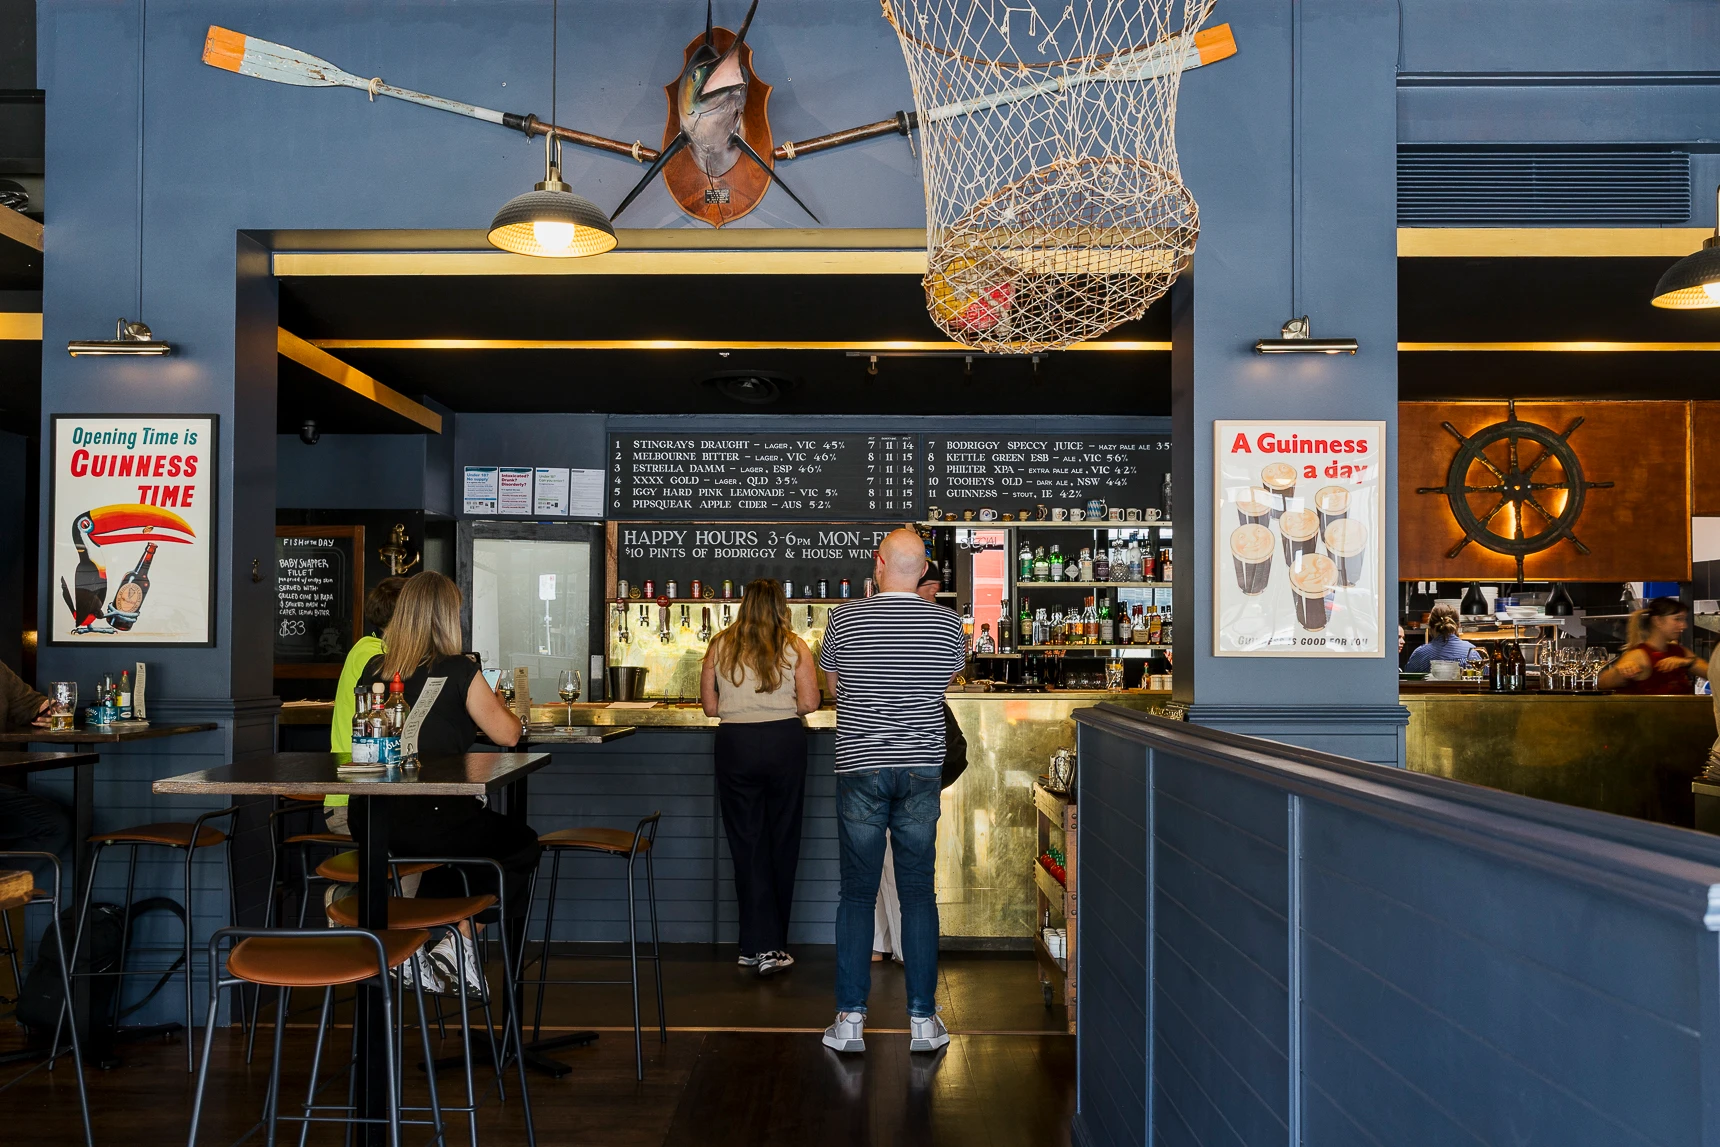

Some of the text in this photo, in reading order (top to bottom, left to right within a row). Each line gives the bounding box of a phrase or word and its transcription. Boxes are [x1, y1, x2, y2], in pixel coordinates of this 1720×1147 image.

[73, 427, 198, 449] Opening Time is
[1231, 432, 1368, 454] A Guinness
[615, 440, 621, 449] 1
[633, 439, 695, 450] STINGRAYS
[700, 440, 750, 450] DRAUGHT
[796, 440, 816, 450] VIC
[867, 440, 915, 449] 7 11 14
[928, 440, 936, 449] 7
[946, 440, 1001, 450] BODRIGGY
[1007, 441, 1048, 450] SPECCY
[1053, 440, 1084, 452] JUICE
[615, 451, 622, 460] 2
[632, 451, 697, 461] MELBOURNE
[701, 452, 740, 461] BITTER
[786, 452, 807, 462] VIC
[867, 452, 913, 461] 8 11 15
[927, 452, 935, 461] 8
[946, 452, 986, 462] KETTLE
[991, 453, 1025, 462] GREEN
[1030, 453, 1050, 462] ESB
[1082, 453, 1102, 462] VIC
[71, 449, 198, 478] GUINNESS
[614, 463, 621, 472] 3
[632, 463, 685, 473] ESTRELLA
[689, 464, 726, 473] DAMM
[772, 464, 793, 474] ESP
[867, 464, 915, 473] 7 11 14
[927, 464, 935, 473] 9
[946, 464, 987, 474] PHILTER
[993, 465, 1015, 474] XPA
[1090, 465, 1111, 475] VIC
[1303, 460, 1369, 484] a day
[614, 475, 622, 484] 4
[632, 475, 664, 485] XXXX
[669, 475, 700, 485] GOLD
[746, 476, 769, 487] QLD
[866, 476, 915, 485] 7 11 14
[928, 476, 939, 485] 10
[946, 476, 995, 486] TOOHEYS
[1001, 476, 1023, 486] OLD
[1076, 477, 1101, 486] NSW
[138, 485, 195, 508] TIME
[613, 487, 838, 497] 5 IGGY HARD PINK LEMONADE VIC 5%
[868, 488, 913, 497] 8 11 15
[928, 488, 937, 497] 11
[946, 488, 998, 498] GUINNESS
[1041, 489, 1053, 498] IE
[613, 499, 621, 508] 6
[632, 499, 693, 510] PIPSQUEAK
[699, 499, 732, 509] APPLE
[738, 499, 768, 509] CIDER
[780, 500, 802, 509] AUS
[868, 500, 913, 509] 8 11 15
[283, 538, 304, 546] FISH
[318, 538, 335, 547] DAY
[624, 530, 688, 546] HAPPY
[695, 530, 759, 546] HOURS
[625, 547, 644, 558] $10
[649, 547, 686, 558] PINTS
[692, 547, 709, 558] OF
[714, 547, 777, 559] BODRIGGY
[784, 547, 796, 558] &
[801, 548, 843, 558] HOUSE
[279, 558, 329, 569] BABY SNAPPER
[287, 569, 314, 577] FILLET
[278, 584, 302, 592] SERVED
[279, 618, 306, 638] $33
[1300, 637, 1326, 646] GOOD
